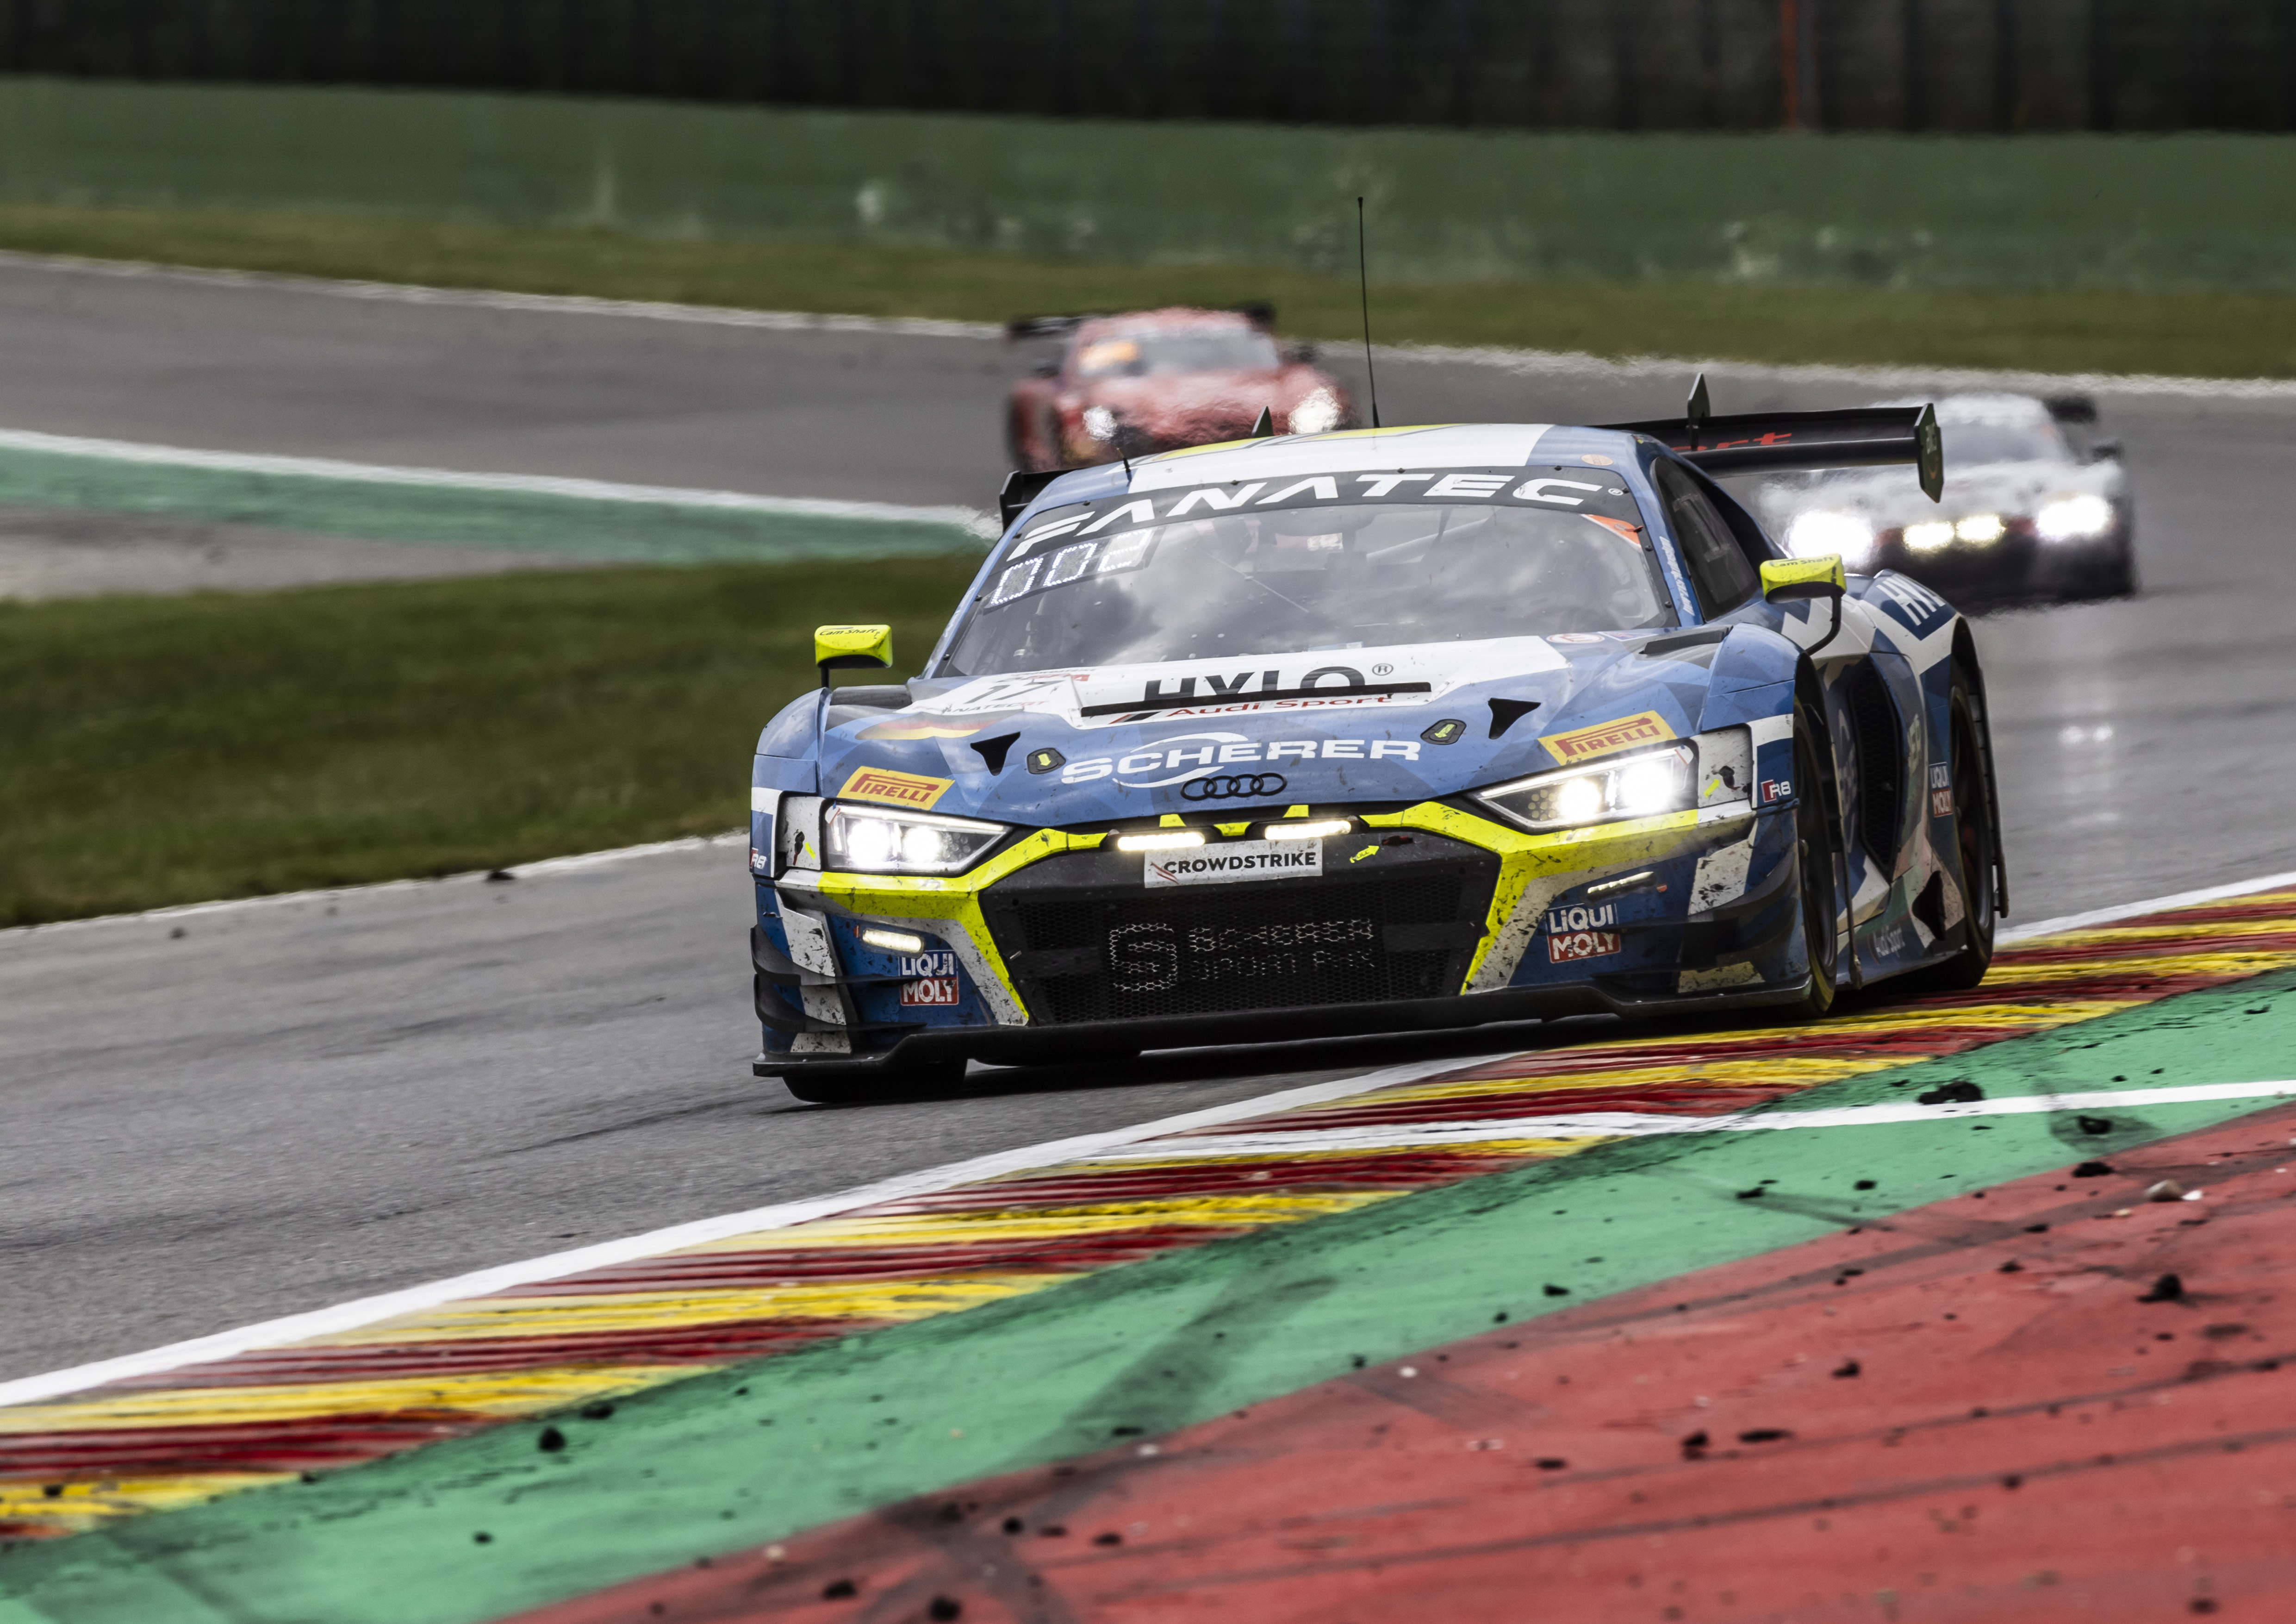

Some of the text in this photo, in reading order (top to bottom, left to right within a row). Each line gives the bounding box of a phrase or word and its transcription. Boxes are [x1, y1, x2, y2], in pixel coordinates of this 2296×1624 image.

[1007, 473, 1603, 561] FANATEC
[1166, 696, 1392, 717] Audi Sport
[1554, 718, 1661, 757] PIRELLI
[1061, 739, 1421, 784] SCHERER
[850, 773, 940, 803] PIRELLI
[1769, 781, 1792, 799] R8
[1163, 852, 1316, 875] CROWDSTRIKE
[1549, 904, 1616, 933] LIQUI
[1552, 932, 1616, 960] MOLY
[901, 952, 955, 976] LIQUI
[903, 979, 956, 1003] MOLY
